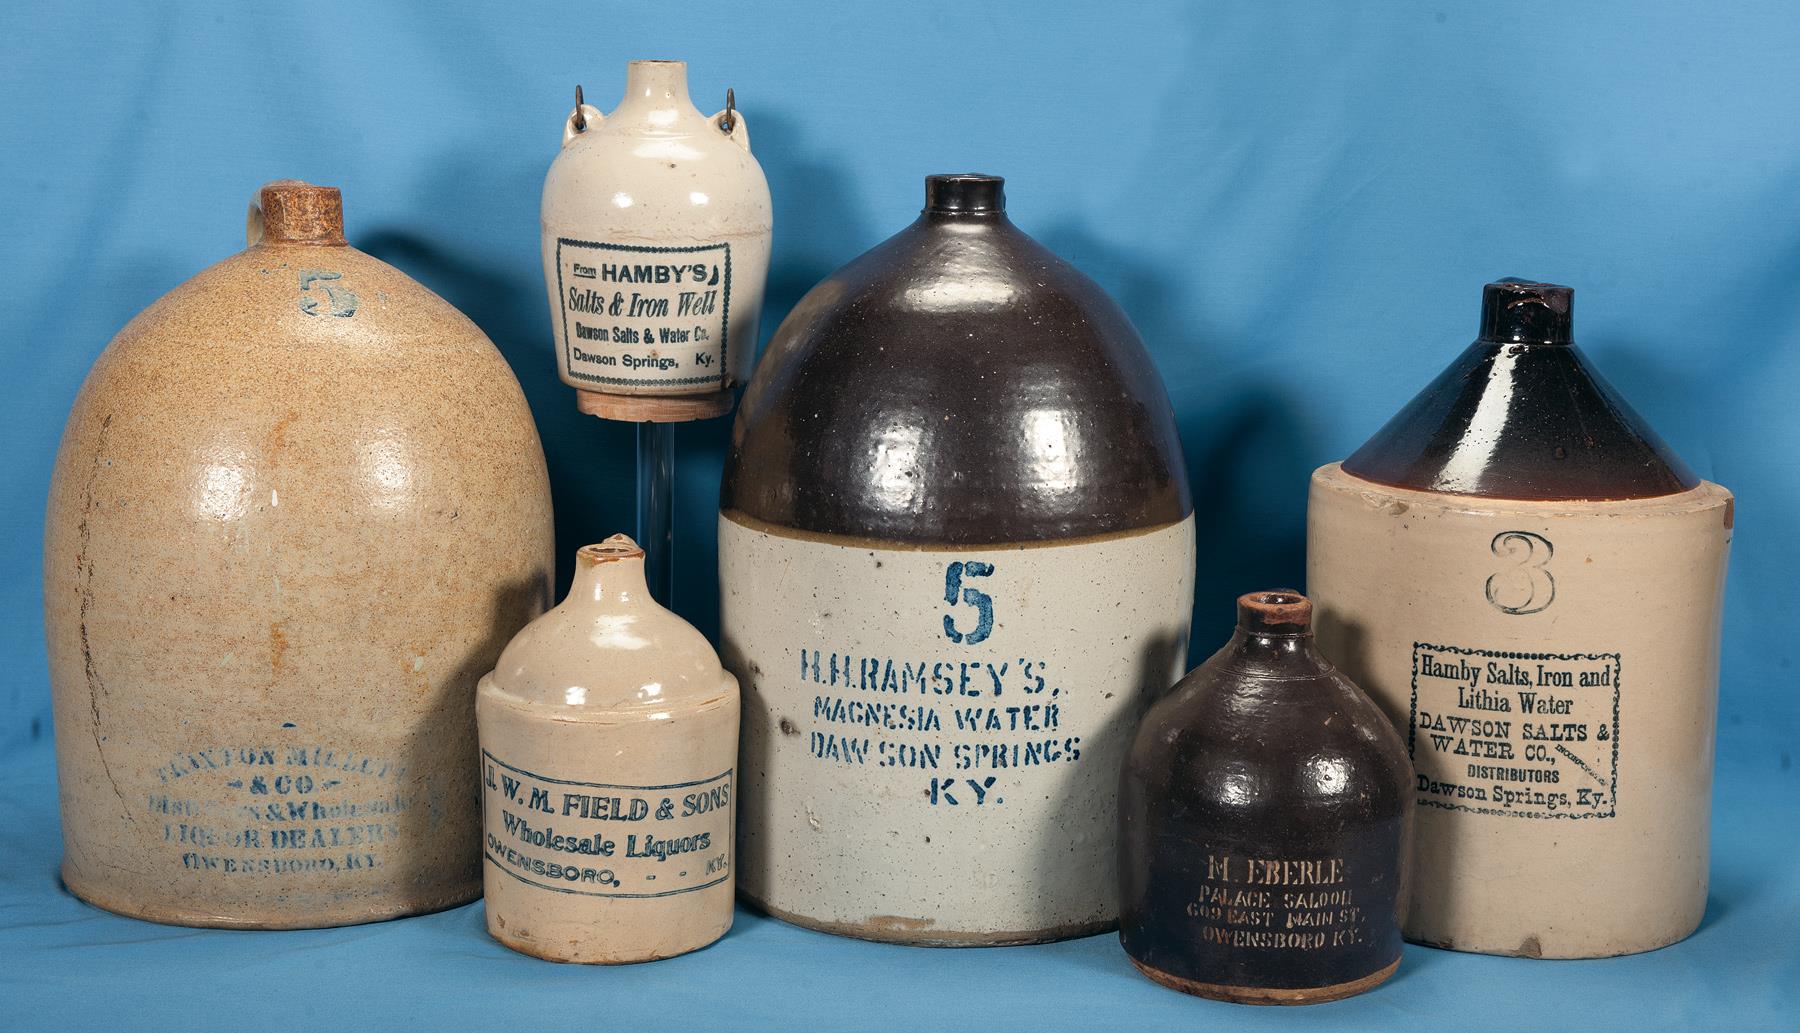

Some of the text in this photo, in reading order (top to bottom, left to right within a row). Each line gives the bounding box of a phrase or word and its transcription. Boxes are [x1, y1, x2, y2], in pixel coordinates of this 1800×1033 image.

[573, 263, 597, 276] From
[300, 269, 357, 318] 5
[568, 286, 718, 318] Salts & Iron Well
[575, 321, 609, 342] Dawson
[612, 325, 640, 344] Salts
[643, 327, 655, 344] &
[659, 327, 691, 344] Water
[573, 347, 715, 370] Dawson Springs, Ky.
[1485, 530, 1556, 616] 3
[943, 561, 995, 646] 5
[1420, 653, 1611, 690] Hamby Salts, Iron and
[814, 695, 1060, 732] MAGNESIA WATER
[1458, 686, 1574, 715] Lithia Water
[1419, 711, 1610, 742] DAWSON SALTS &
[954, 736, 1081, 770] SPRINGS
[1430, 733, 1556, 767] WATER CO.,
[1467, 763, 1560, 784] DISTRIBUTORS
[485, 764, 730, 822] J. W. M. FIELD & SONS
[930, 776, 1004, 806] KY.
[1416, 774, 1608, 811] Dawson Springs, Ky.
[502, 809, 712, 862] Wholesale Liquors
[486, 832, 728, 888] OWENSBORO, KY.
[1247, 858, 1345, 885] EBERLE
[1198, 884, 1271, 909] PALACE
[1186, 901, 1222, 920] 609
[1227, 908, 1275, 927] EAST
[1285, 911, 1334, 929] MAIN
[1202, 926, 1325, 949] OWENSBORO
